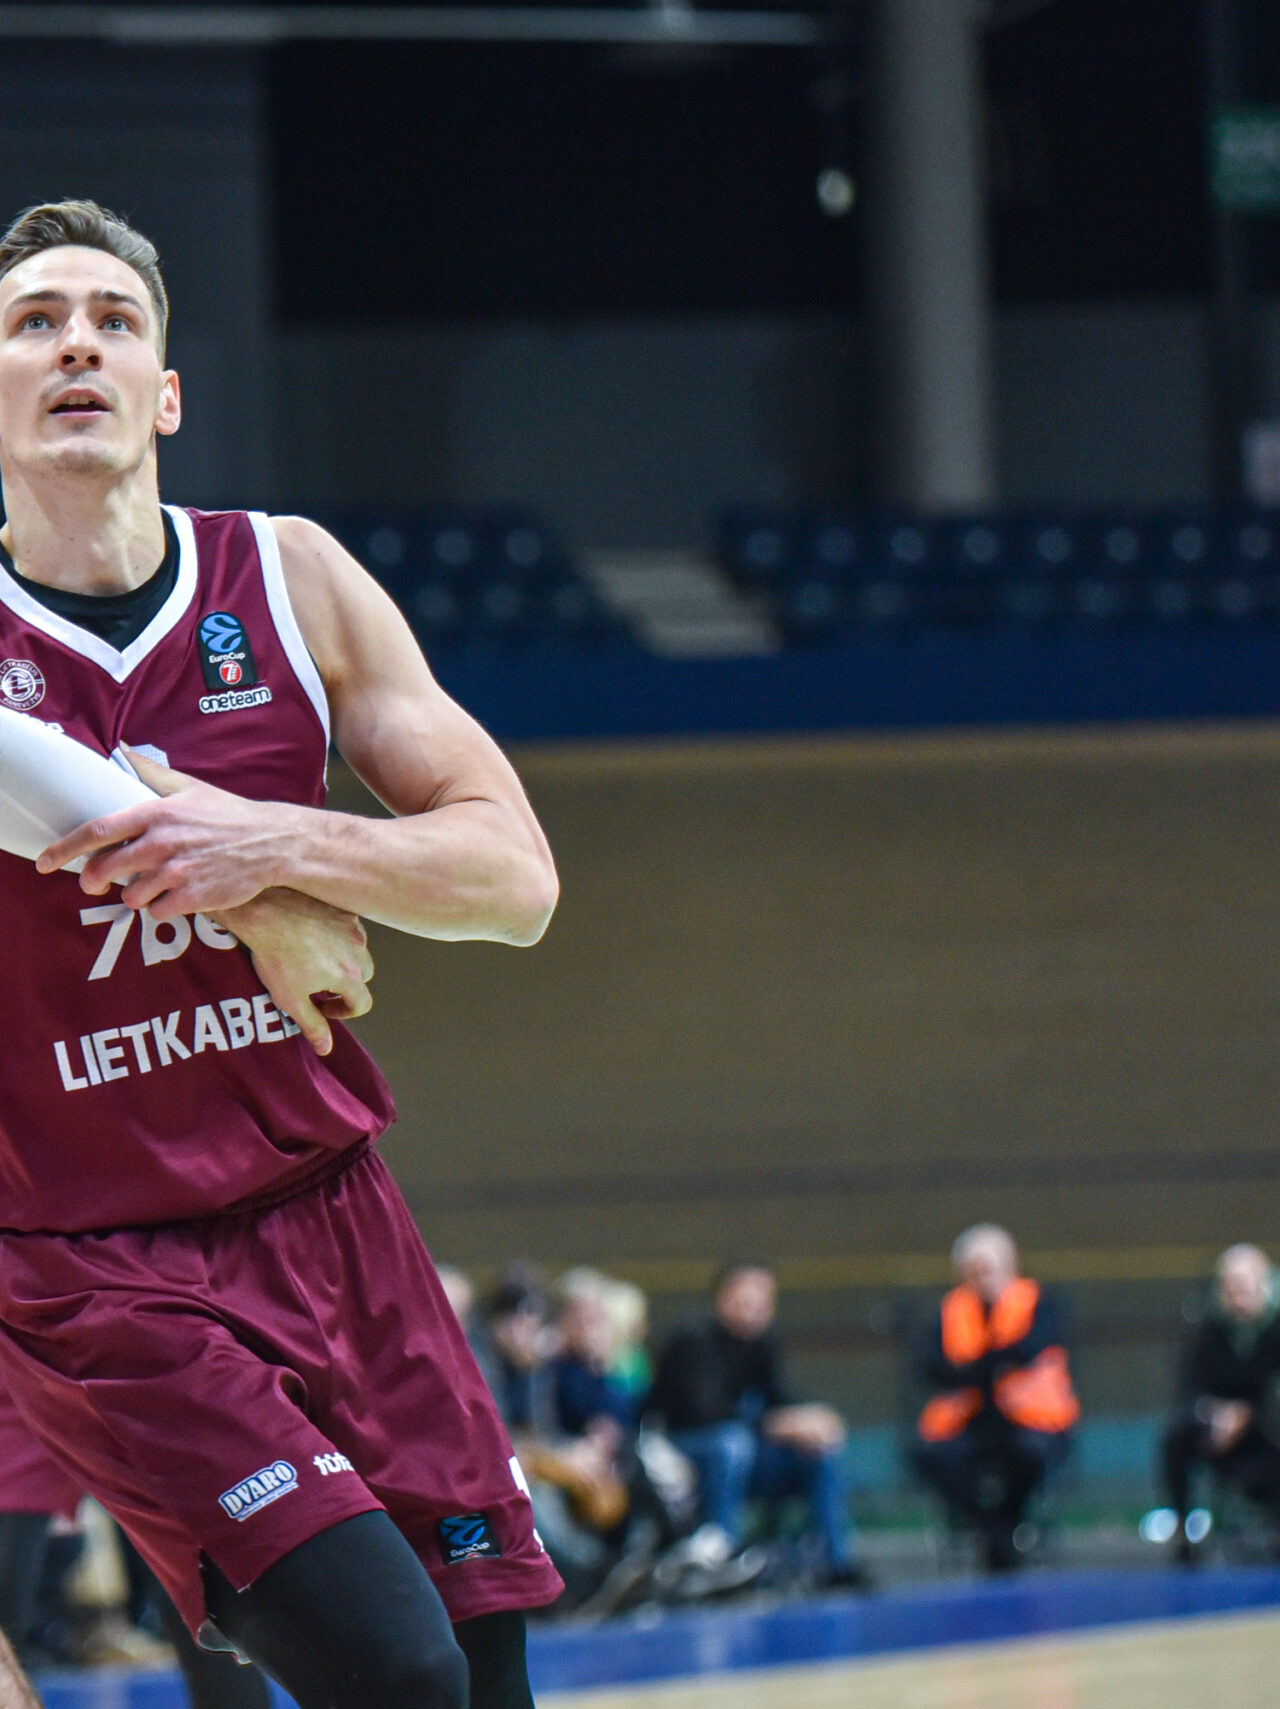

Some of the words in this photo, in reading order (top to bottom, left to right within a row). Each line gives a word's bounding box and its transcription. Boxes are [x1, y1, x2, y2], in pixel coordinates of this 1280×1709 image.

[208, 652, 245, 663] EuroCup
[200, 688, 271, 712] oneteam
[220, 1461, 295, 1517] DVARO
[450, 1542, 490, 1558] EuroCup
